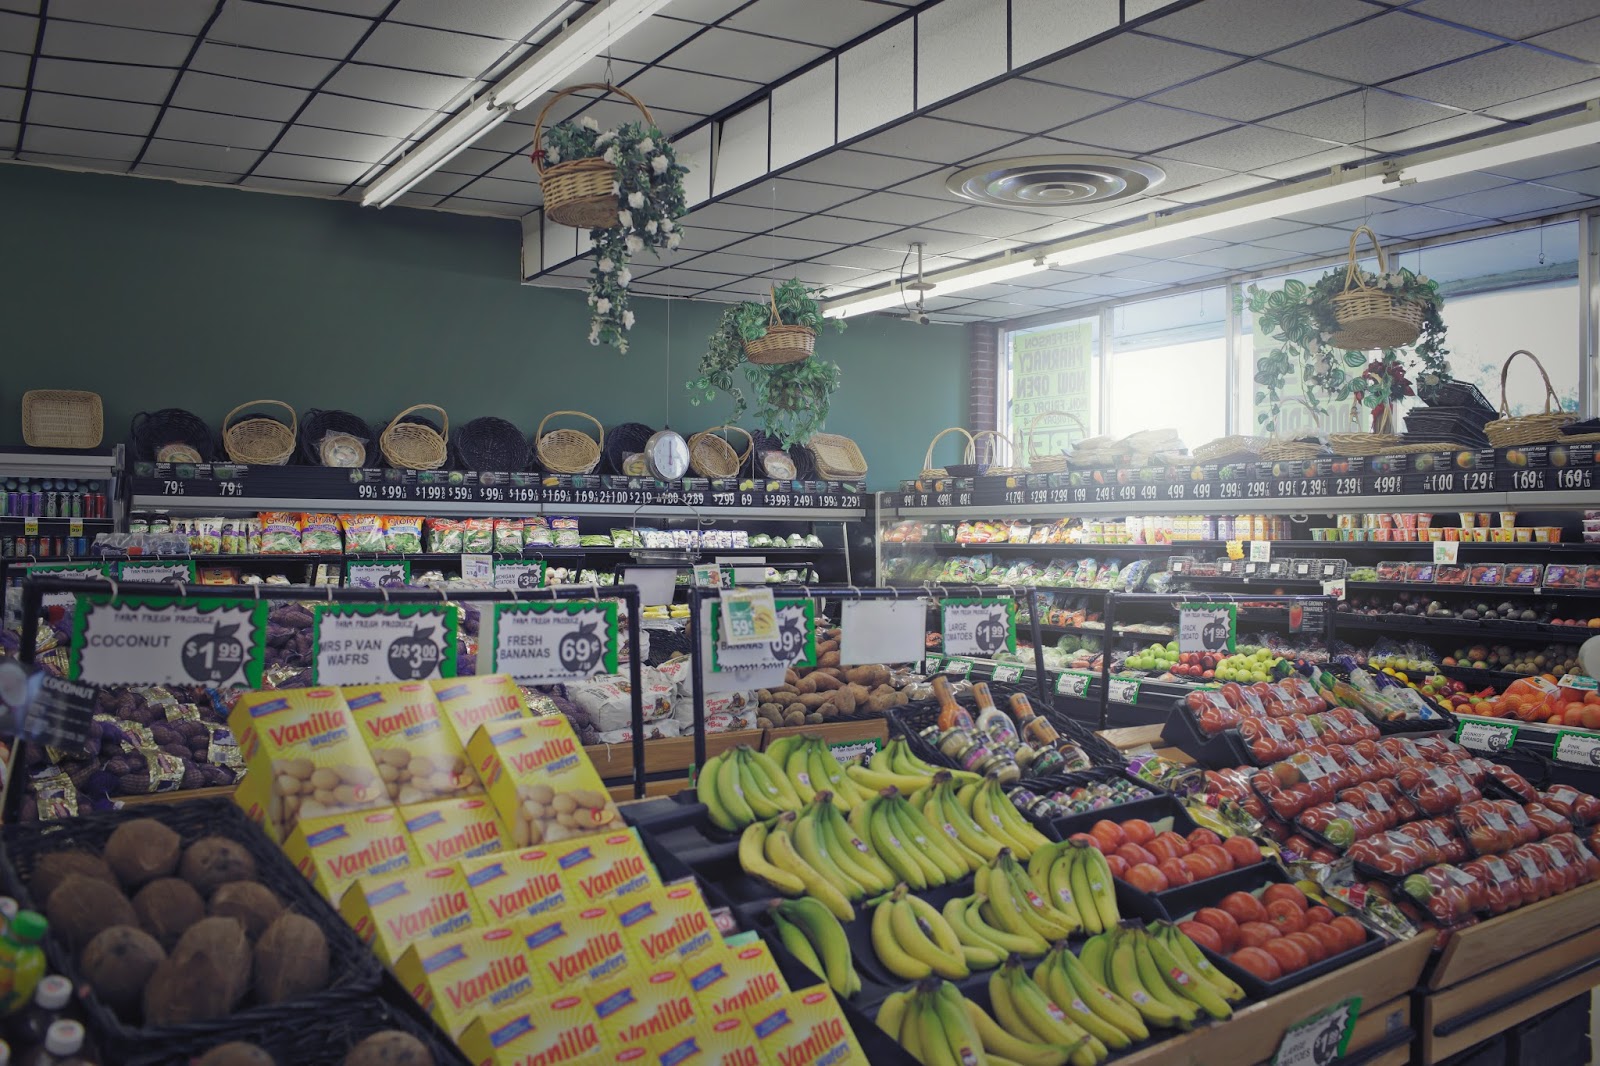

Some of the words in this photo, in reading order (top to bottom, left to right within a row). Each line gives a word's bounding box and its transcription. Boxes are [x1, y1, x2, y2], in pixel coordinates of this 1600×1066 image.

[90, 635, 172, 648] COCONUT
[320, 640, 341, 652] MRS
[344, 640, 353, 651] P
[355, 640, 382, 651] VAN
[507, 635, 543, 646] FRESH
[949, 623, 967, 632] LARGE
[327, 653, 369, 666] WAFRS
[500, 648, 551, 660] BANANAS
[269, 709, 346, 747] Vanilla
[366, 703, 438, 737] Vanilla
[510, 738, 576, 774] Vanilla
[1567, 743, 1581, 751] PINK
[327, 835, 407, 879] Vanilla
[426, 820, 500, 863] Vanilla
[489, 872, 563, 919] Vanilla
[579, 855, 646, 899] Vanilla
[387, 891, 470, 942] Vanilla
[641, 911, 708, 959] Vanilla
[548, 931, 623, 984] Vanilla
[445, 953, 530, 1009] Vanilla
